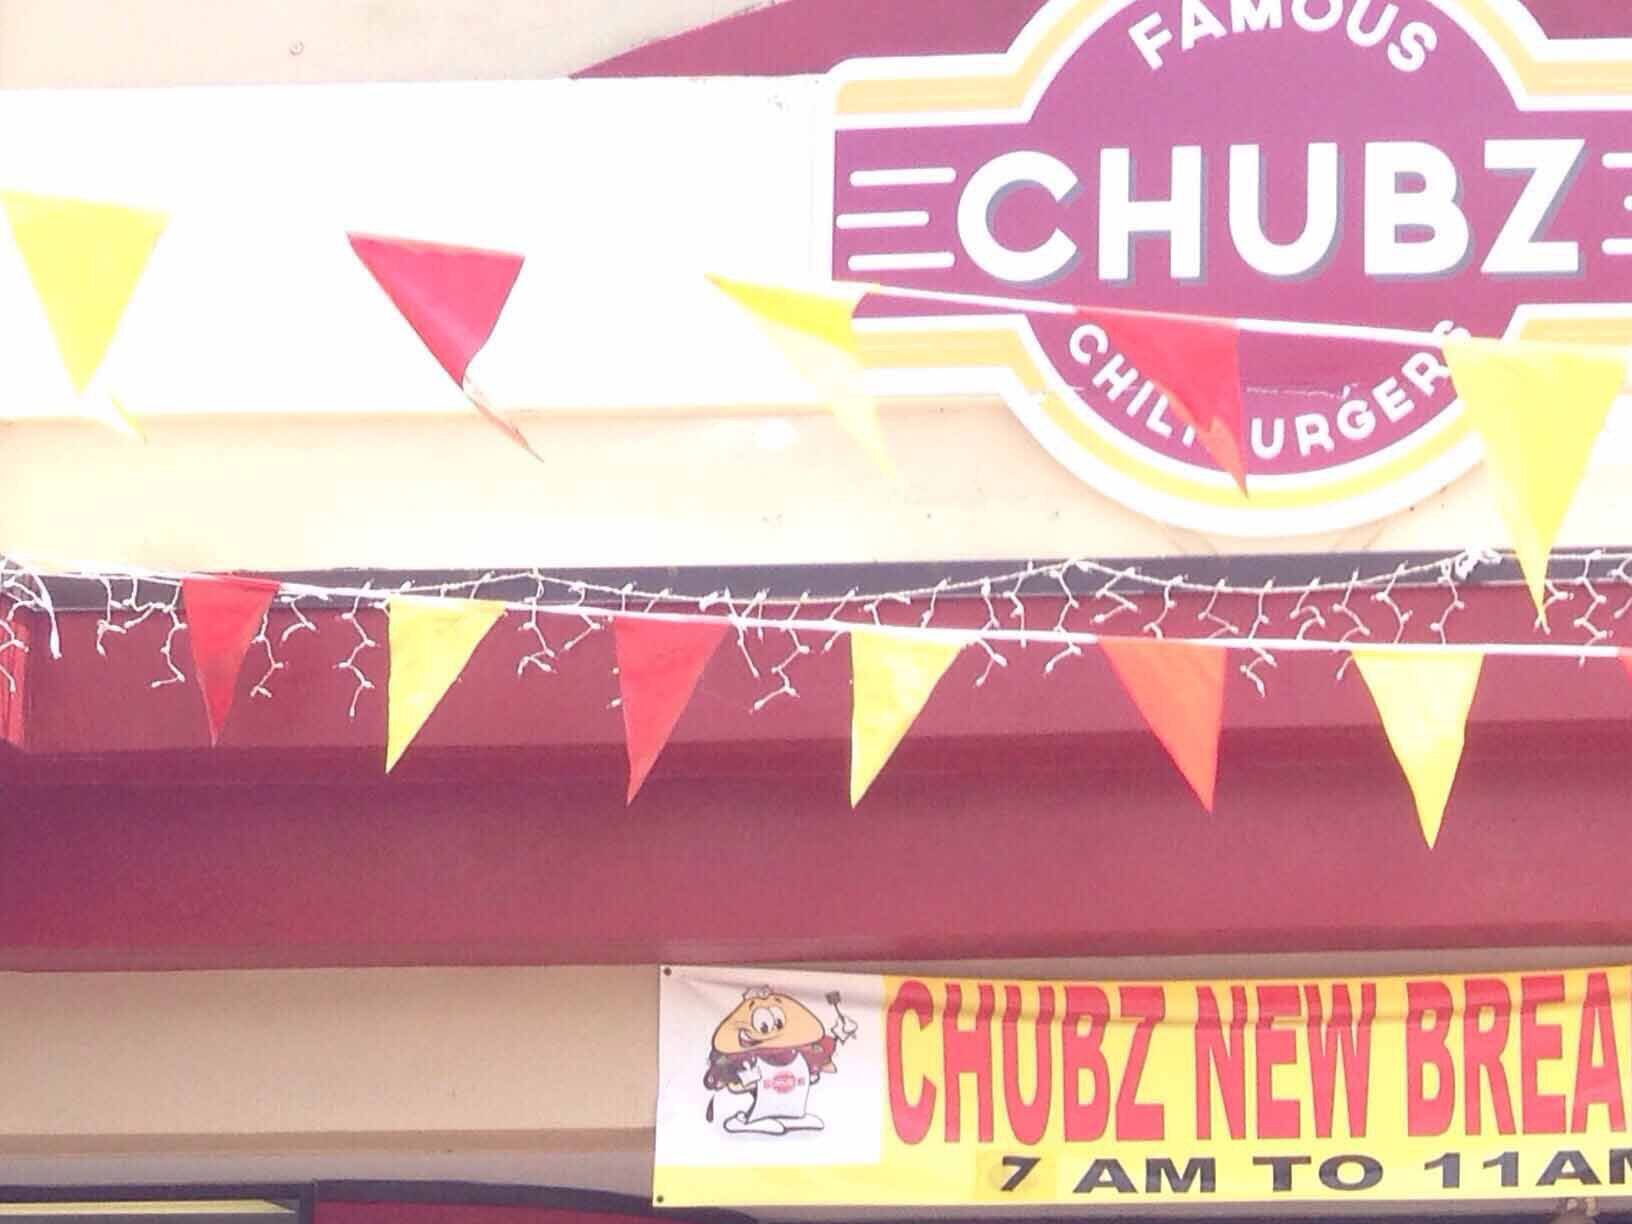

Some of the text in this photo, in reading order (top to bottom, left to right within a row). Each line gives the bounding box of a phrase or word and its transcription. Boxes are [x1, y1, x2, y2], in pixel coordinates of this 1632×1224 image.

[1128, 0, 1438, 72] FAMOUS
[956, 138, 1588, 284] CHUBZ
[886, 980, 1166, 1146] CHUBZ
[1194, 983, 1377, 1142] NEW
[999, 1156, 1042, 1193] 7
[1073, 1157, 1217, 1194] AM
[1252, 1154, 1384, 1193] TO
